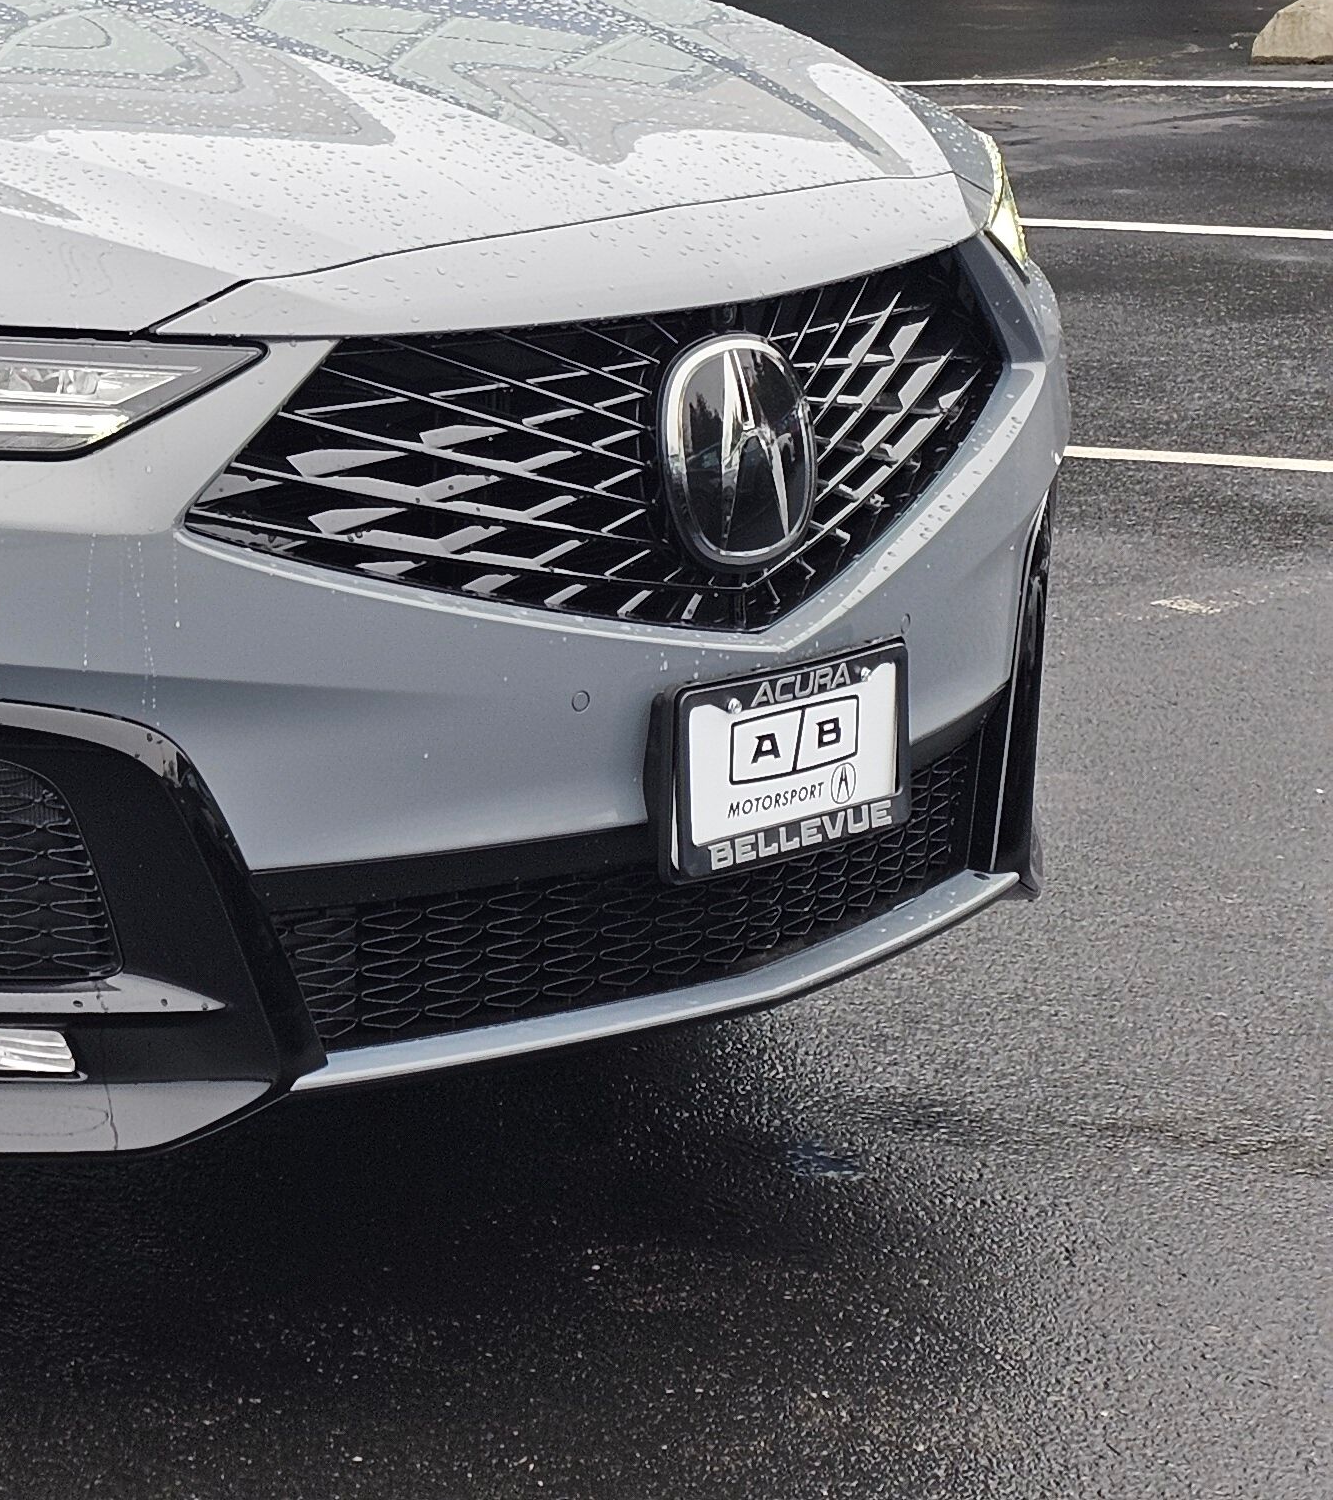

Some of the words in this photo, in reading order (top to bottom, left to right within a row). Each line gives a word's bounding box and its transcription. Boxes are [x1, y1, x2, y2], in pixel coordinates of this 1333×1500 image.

[750, 663, 851, 708] ACURA
[751, 732, 781, 764] A
[816, 717, 842, 748] B
[727, 781, 825, 819] MOTORSPORT
[707, 800, 893, 870] BELLEVUE
